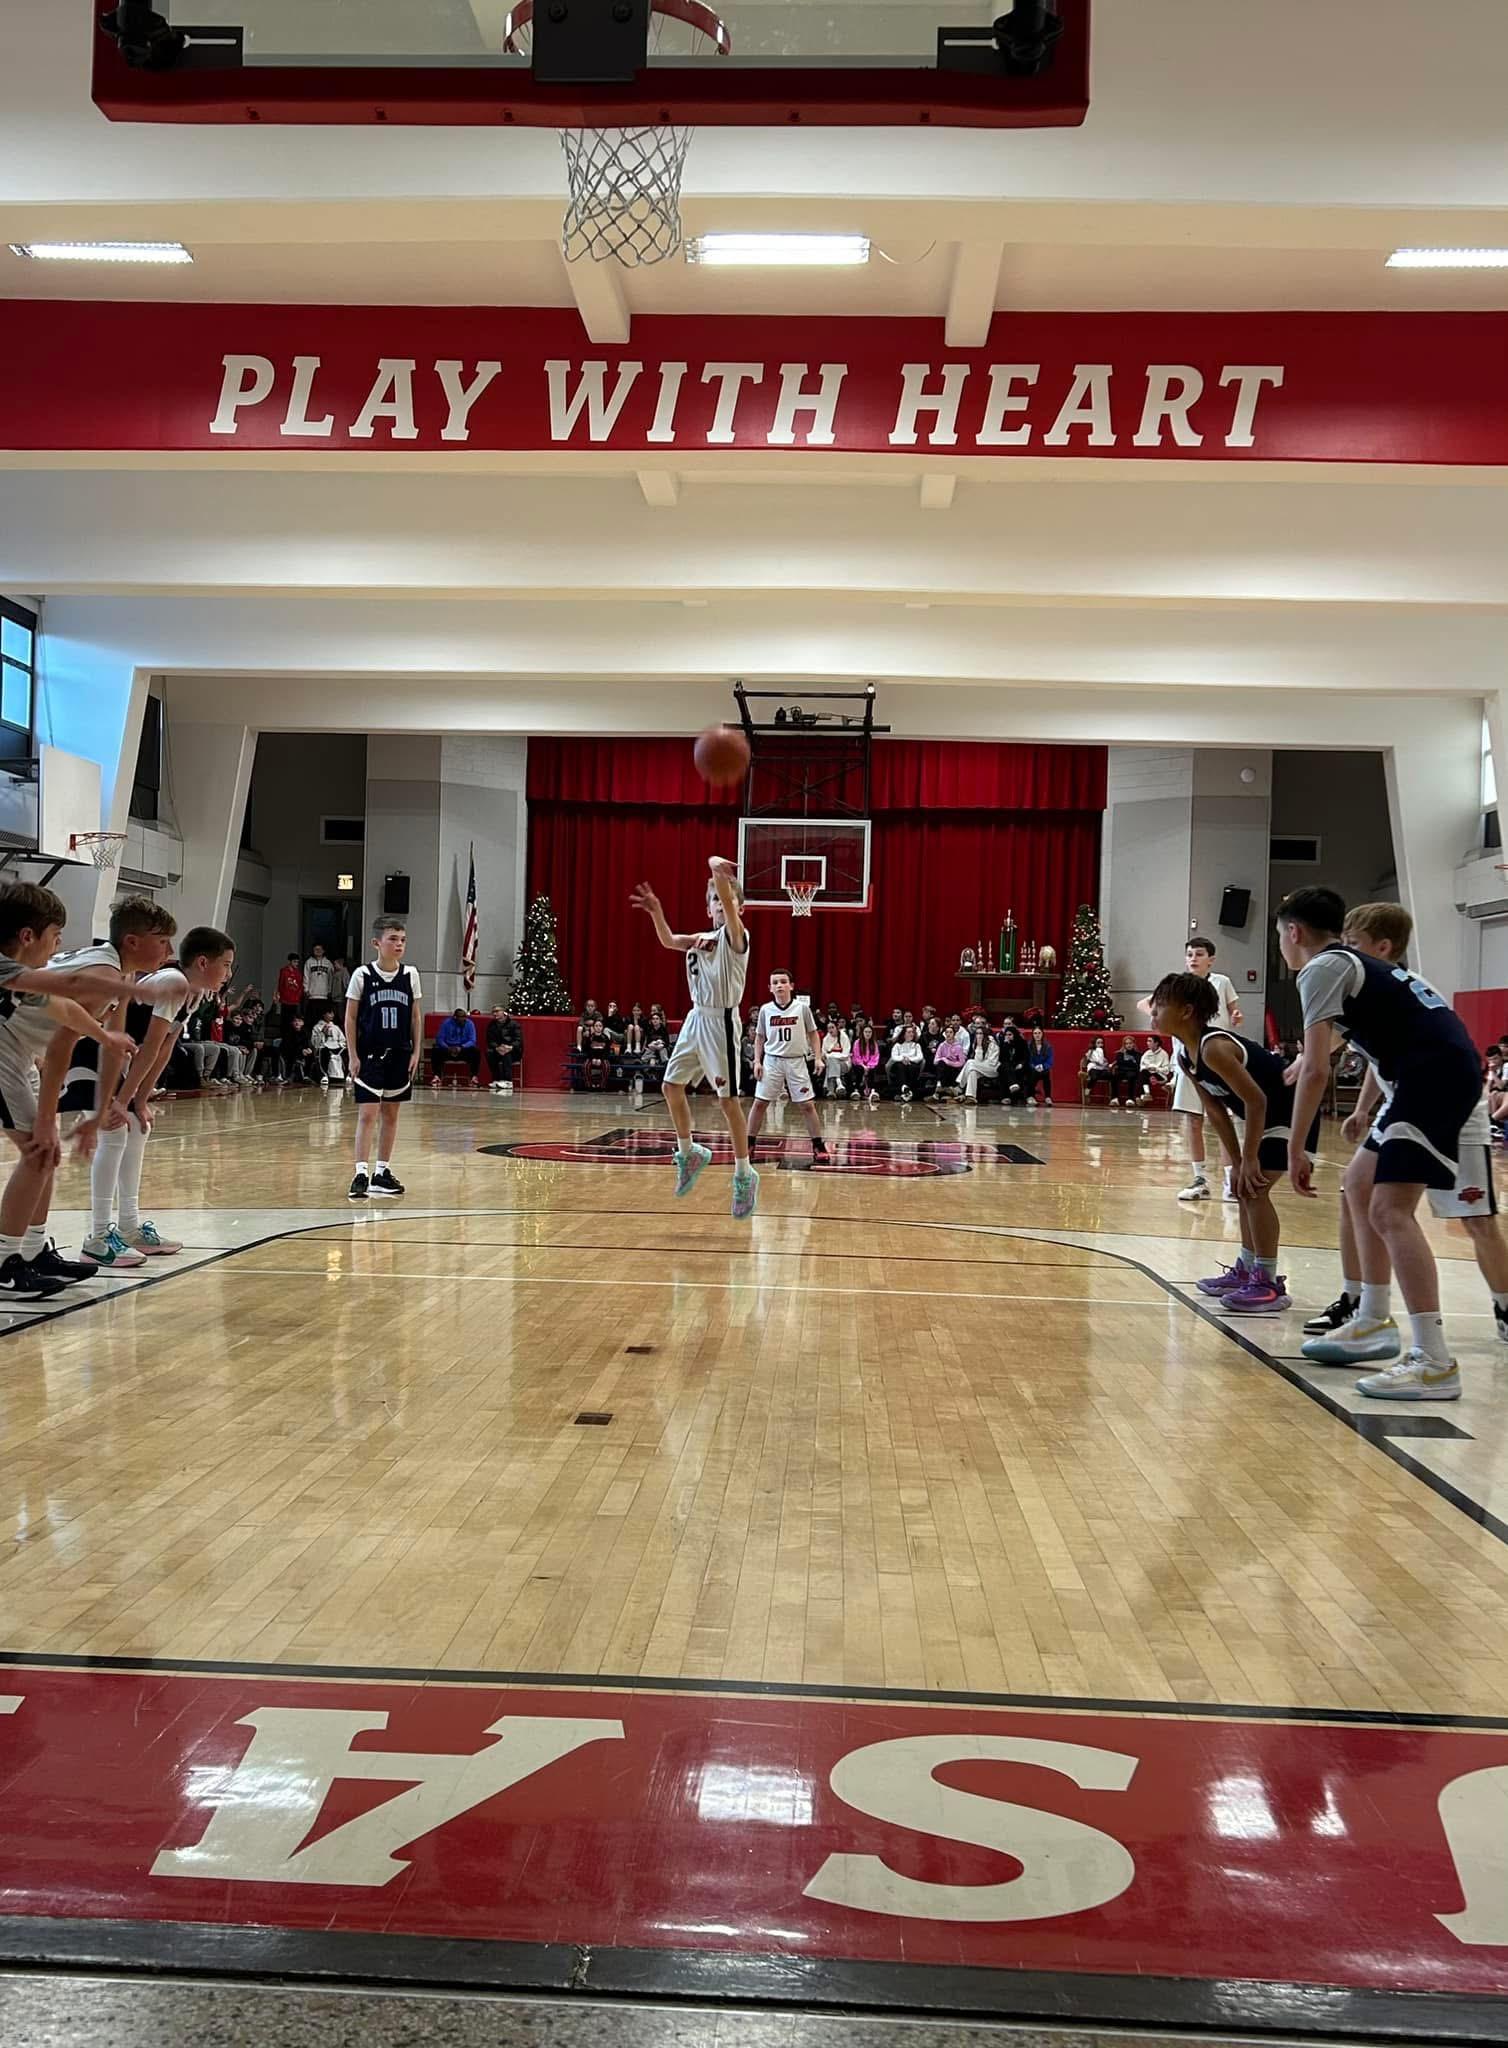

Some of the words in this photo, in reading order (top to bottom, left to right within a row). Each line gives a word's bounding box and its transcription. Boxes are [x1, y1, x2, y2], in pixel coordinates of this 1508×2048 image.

[209, 354, 502, 442] PLAY
[543, 359, 851, 446] WITH
[887, 363, 1285, 449] HEART
[381, 1007, 397, 1029] 11
[779, 1027, 791, 1042] 10
